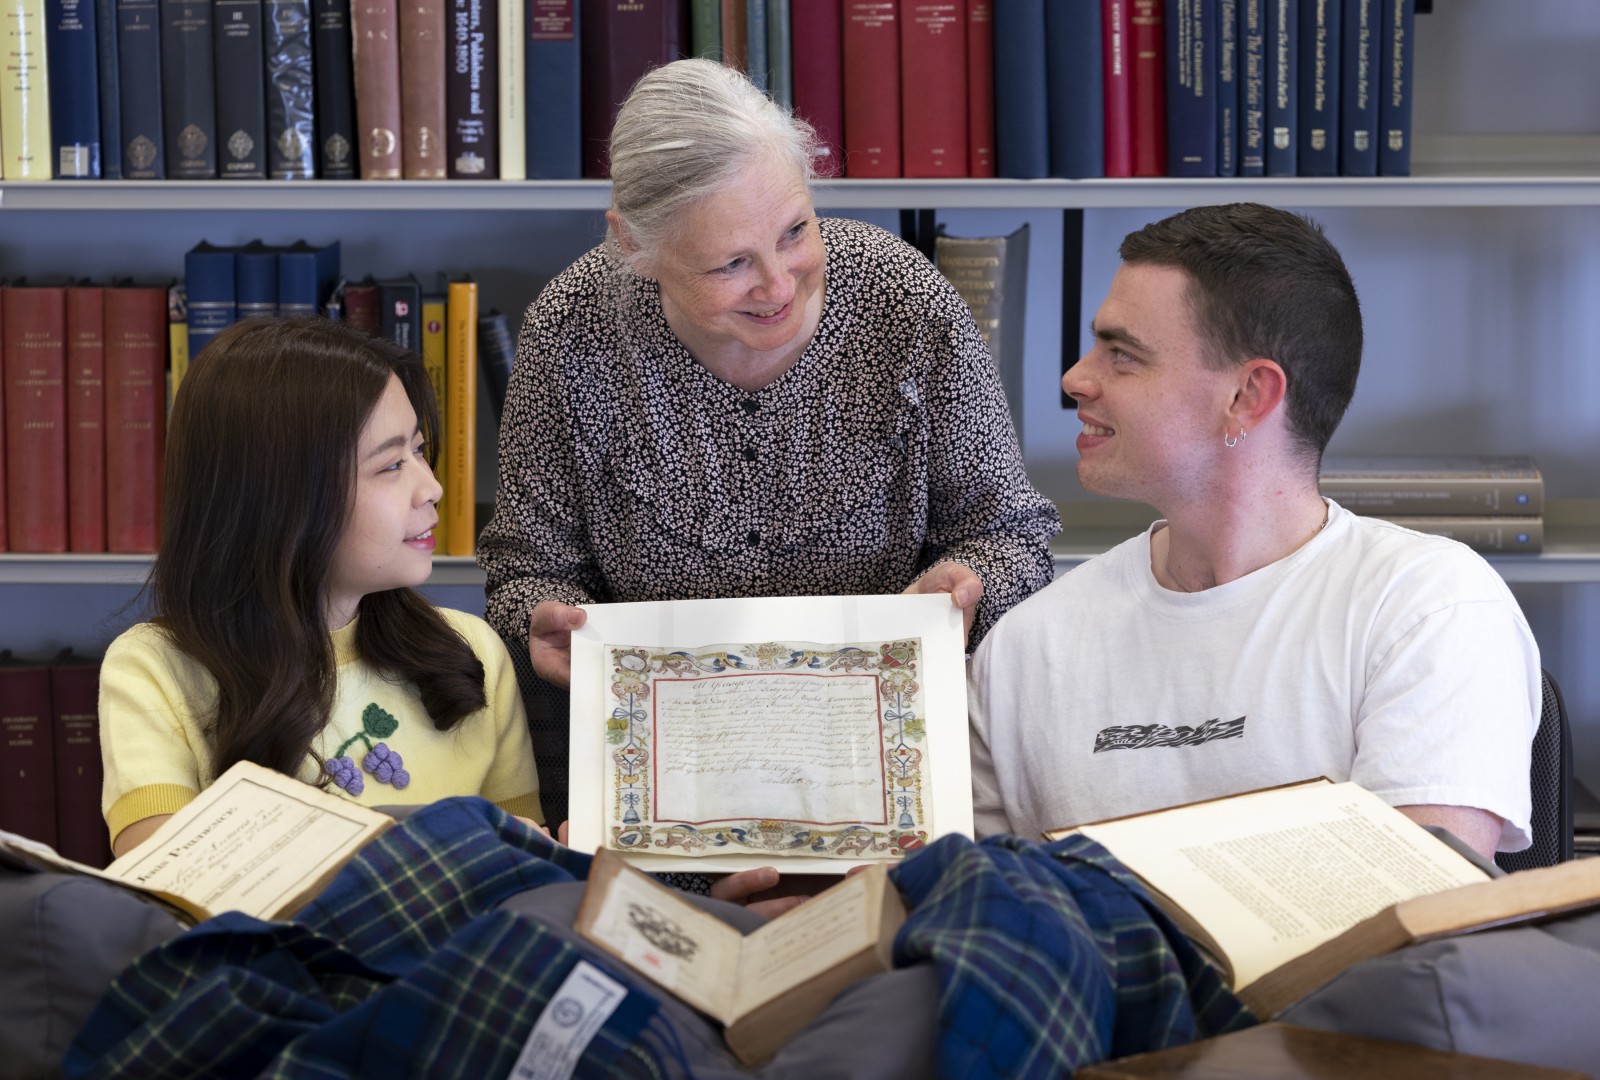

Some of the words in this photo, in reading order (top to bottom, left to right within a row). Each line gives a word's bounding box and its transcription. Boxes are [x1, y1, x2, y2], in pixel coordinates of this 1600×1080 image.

[455, 12, 468, 73] 1640-1800
[1247, 35, 1262, 50] The
[470, 32, 484, 90] Publishers
[1220, 41, 1235, 82] Manuscripts
[1247, 52, 1261, 78] Jesuit
[470, 92, 484, 114] and
[1247, 79, 1261, 104] Series
[1247, 110, 1262, 128] Part
[1248, 130, 1262, 148] One
[939, 256, 1000, 266] MANUSCRIPTS
